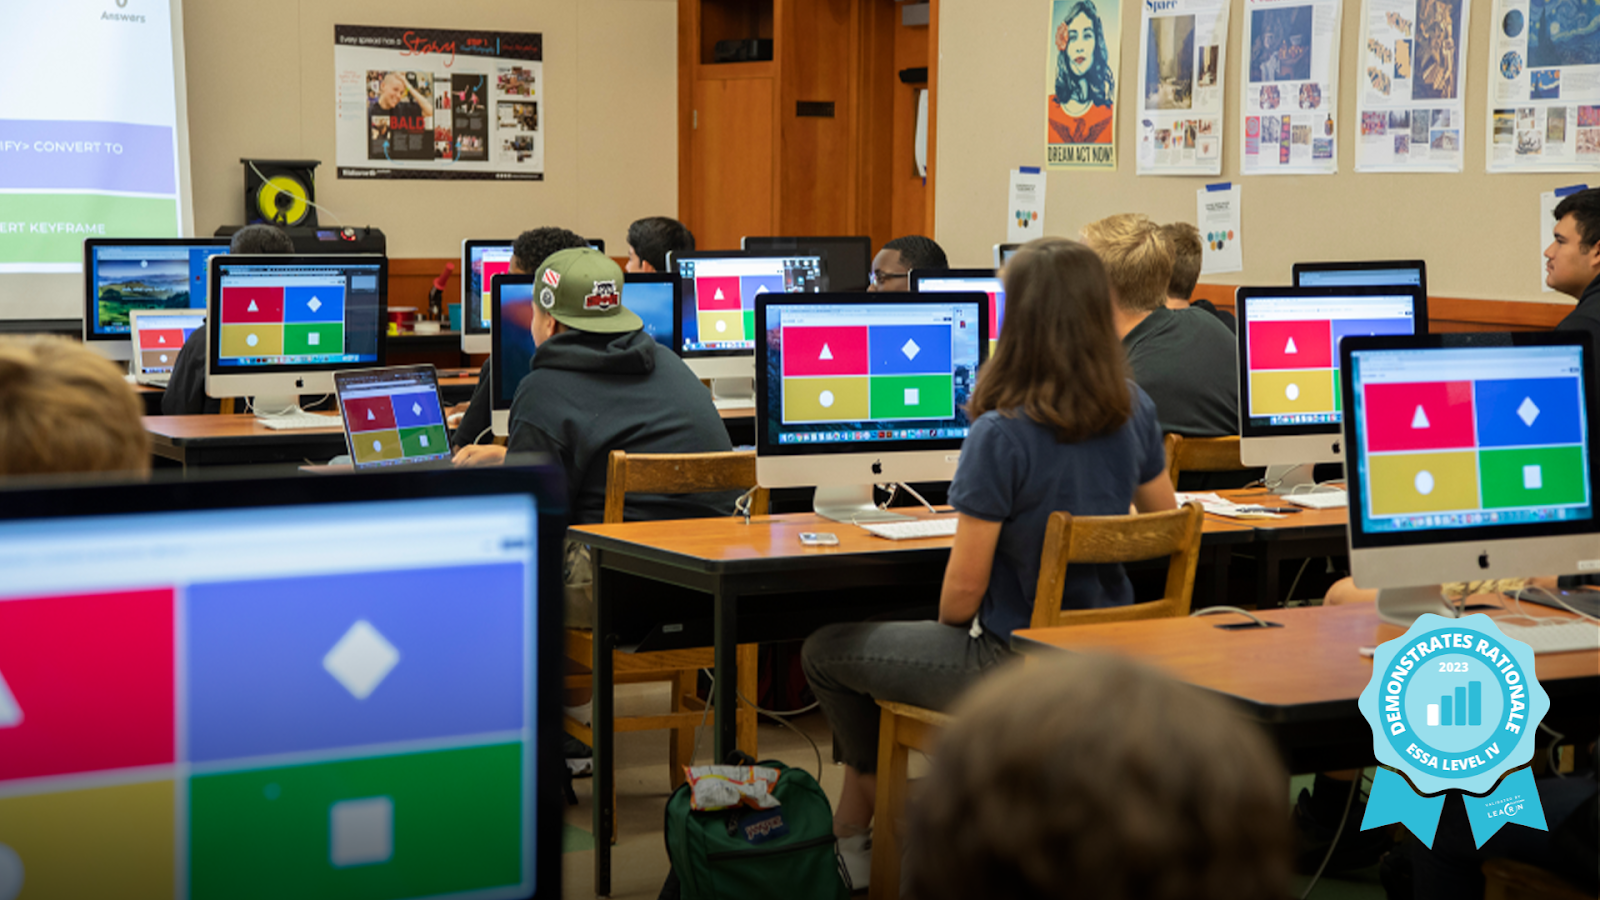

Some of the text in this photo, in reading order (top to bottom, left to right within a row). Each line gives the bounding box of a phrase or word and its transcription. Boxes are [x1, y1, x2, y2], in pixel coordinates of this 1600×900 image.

[100, 11, 146, 23] Answers
[339, 35, 357, 45] Every
[358, 36, 382, 45] spread
[399, 30, 456, 68] Story
[390, 115, 425, 130] BALD
[33, 140, 101, 153] CONVERT
[104, 142, 124, 155] TO
[1047, 146, 1113, 163] DREAM ACT NOW!
[29, 221, 106, 235] KEYFRAME
